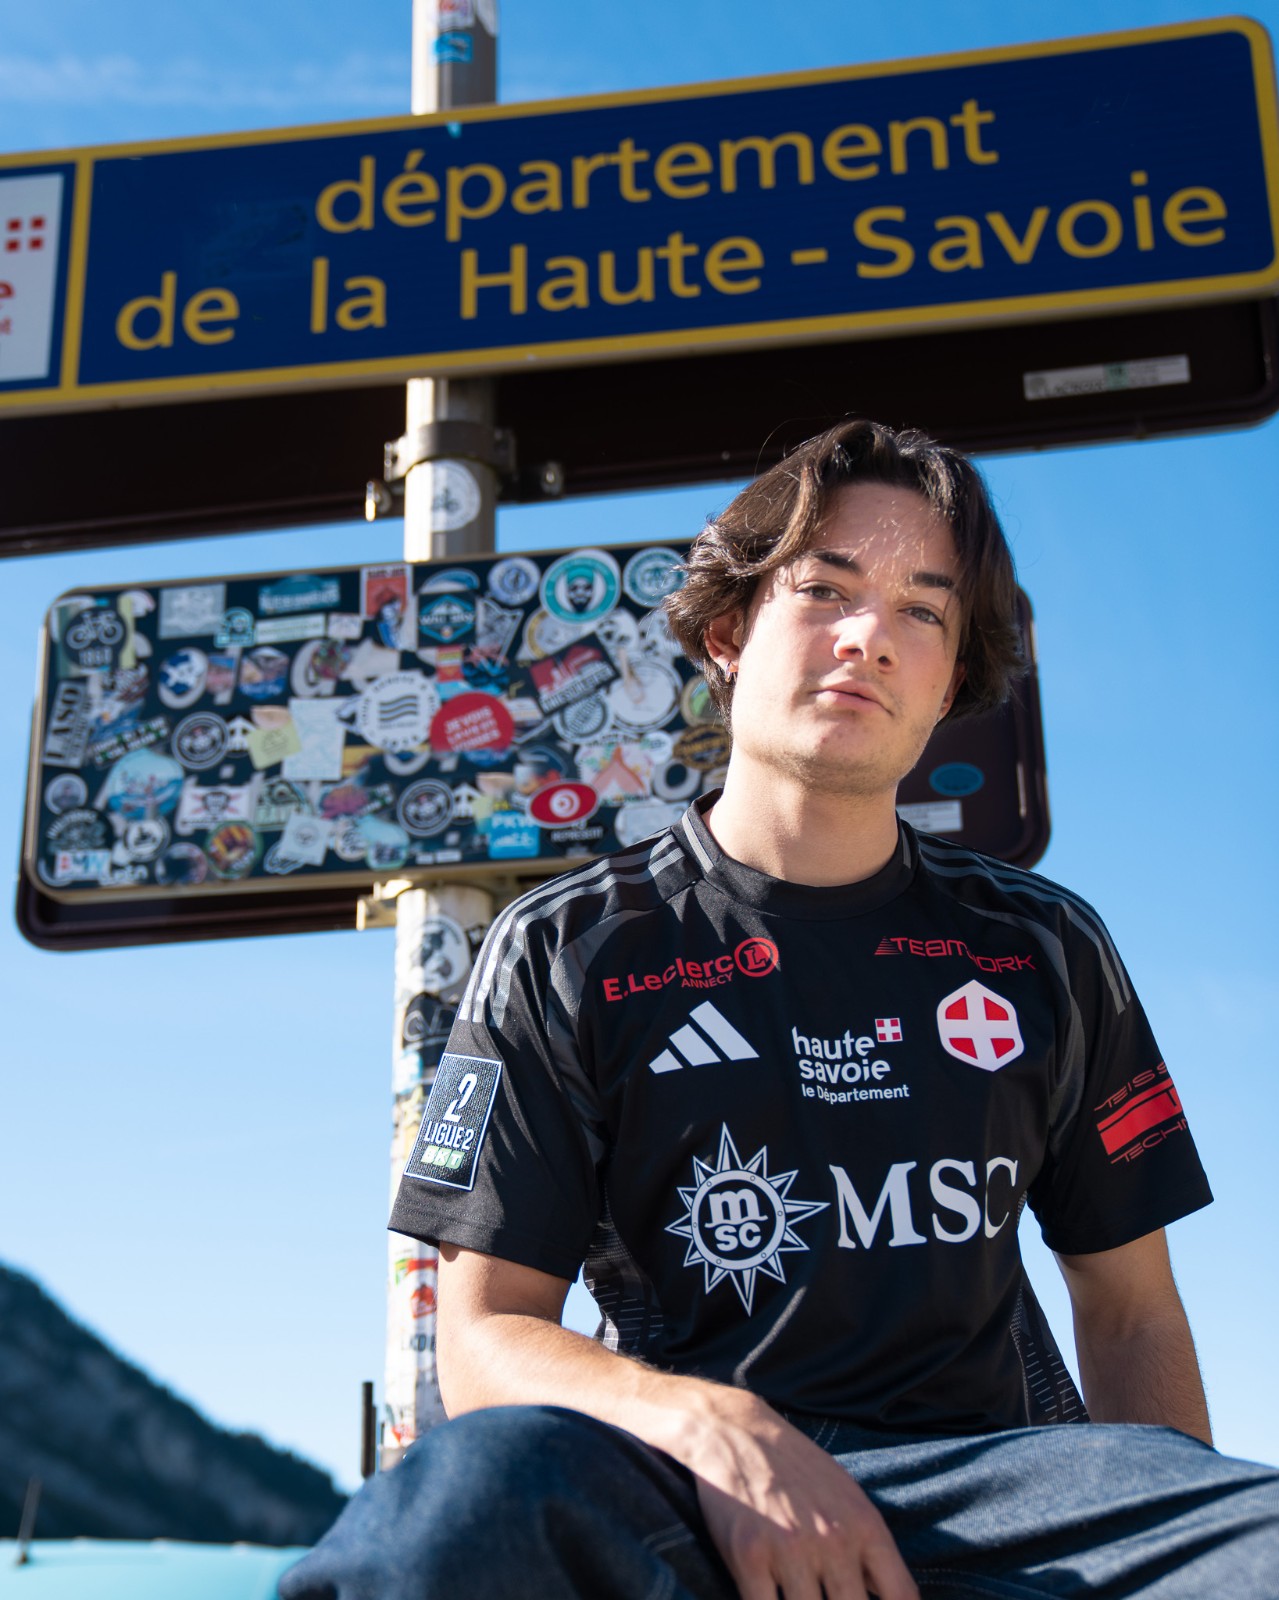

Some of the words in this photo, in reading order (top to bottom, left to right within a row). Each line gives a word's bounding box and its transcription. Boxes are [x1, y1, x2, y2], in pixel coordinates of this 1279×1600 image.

[317, 100, 998, 241] département
[116, 271, 240, 350] de
[311, 257, 386, 332] la
[889, 937, 1036, 973] TEAMORK
[602, 954, 734, 1002] E.Leclerc
[681, 972, 733, 989] ANNECY
[791, 1026, 875, 1060] haute
[798, 1059, 891, 1084] savoie
[443, 1073, 477, 1122] 2
[802, 1083, 815, 1097] le
[816, 1084, 910, 1105] Département
[422, 1146, 465, 1169] BKT
[829, 1156, 1018, 1249] MSC
